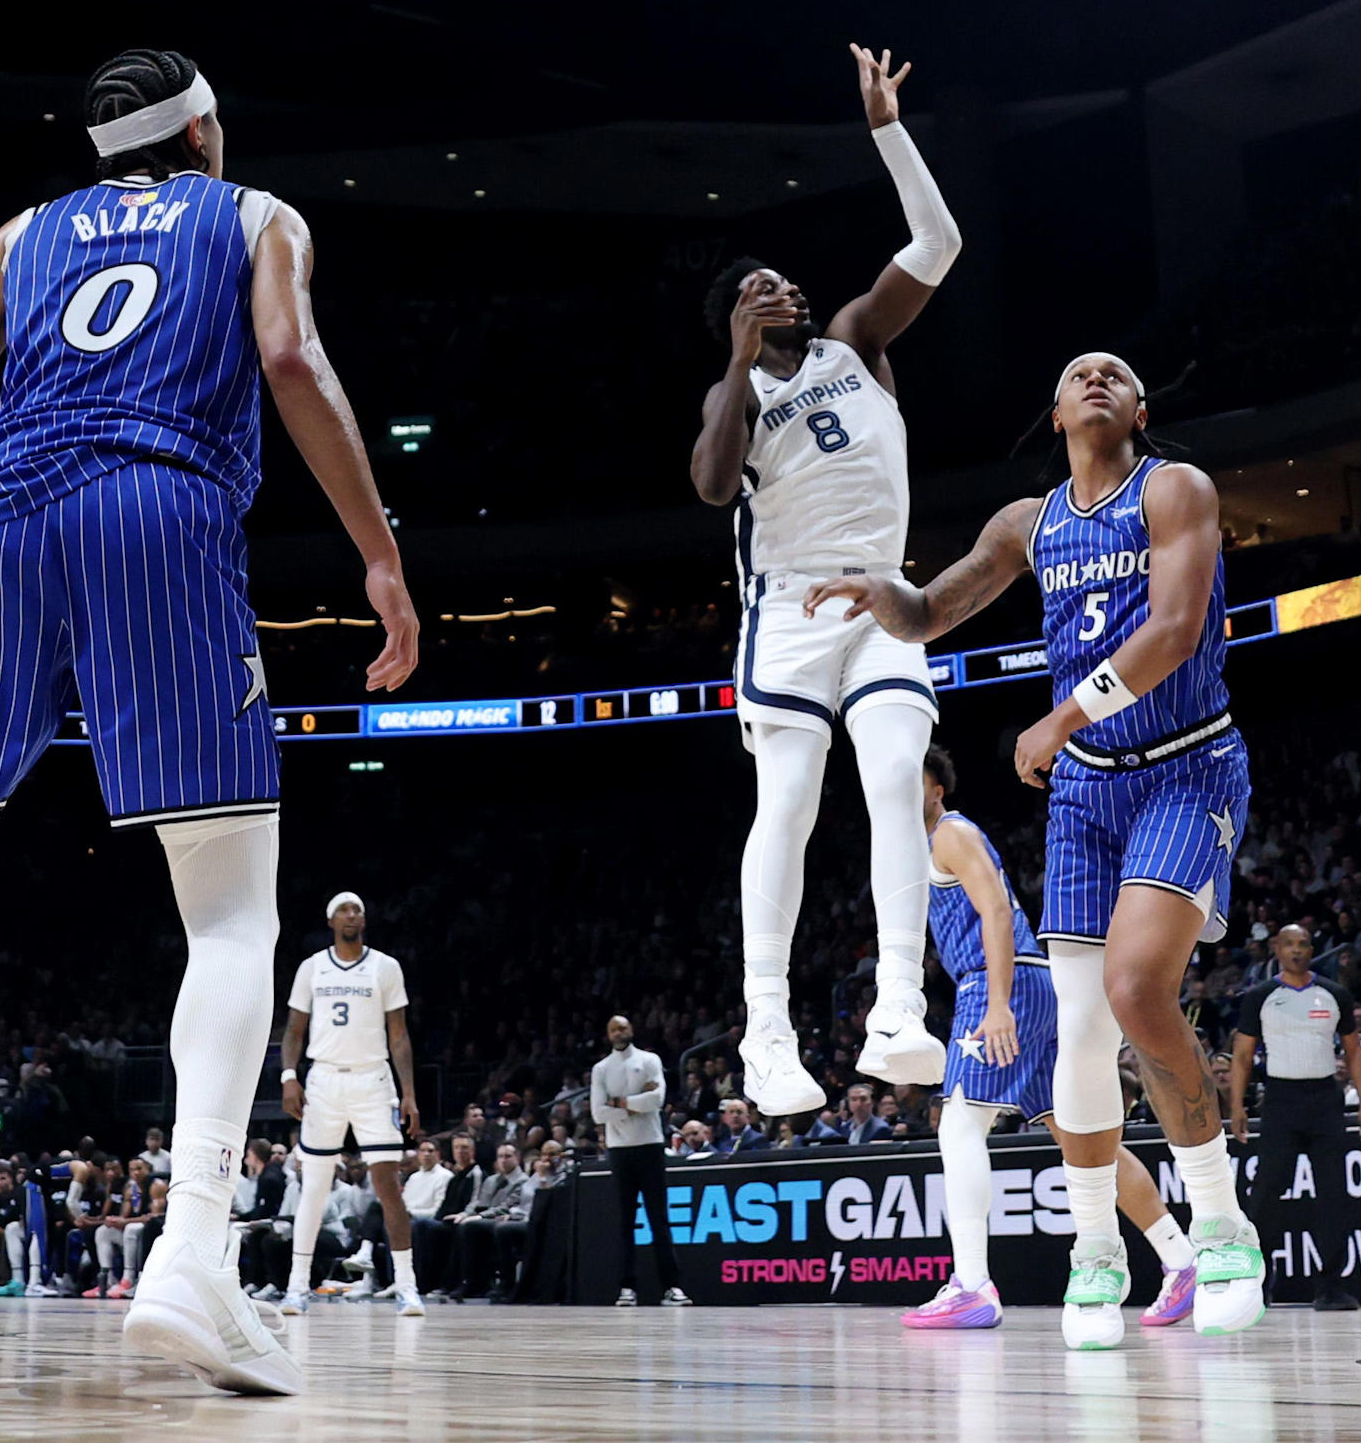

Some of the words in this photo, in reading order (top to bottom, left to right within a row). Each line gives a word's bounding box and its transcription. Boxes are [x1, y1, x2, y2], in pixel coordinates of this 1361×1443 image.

[70, 200, 190, 243] BLACK
[61, 261, 161, 354] 0
[762, 374, 862, 432] MEMPHIS
[806, 410, 850, 454] 8
[1078, 591, 1110, 642] 5
[1092, 672, 1116, 694] 5
[455, 707, 511, 726] MAGIC
[540, 700, 557, 725] 12
[315, 987, 373, 998] MEMPHIS
[332, 1002, 349, 1026] 3
[721, 1258, 826, 1284] STRONG
[850, 1256, 952, 1282] SMART
